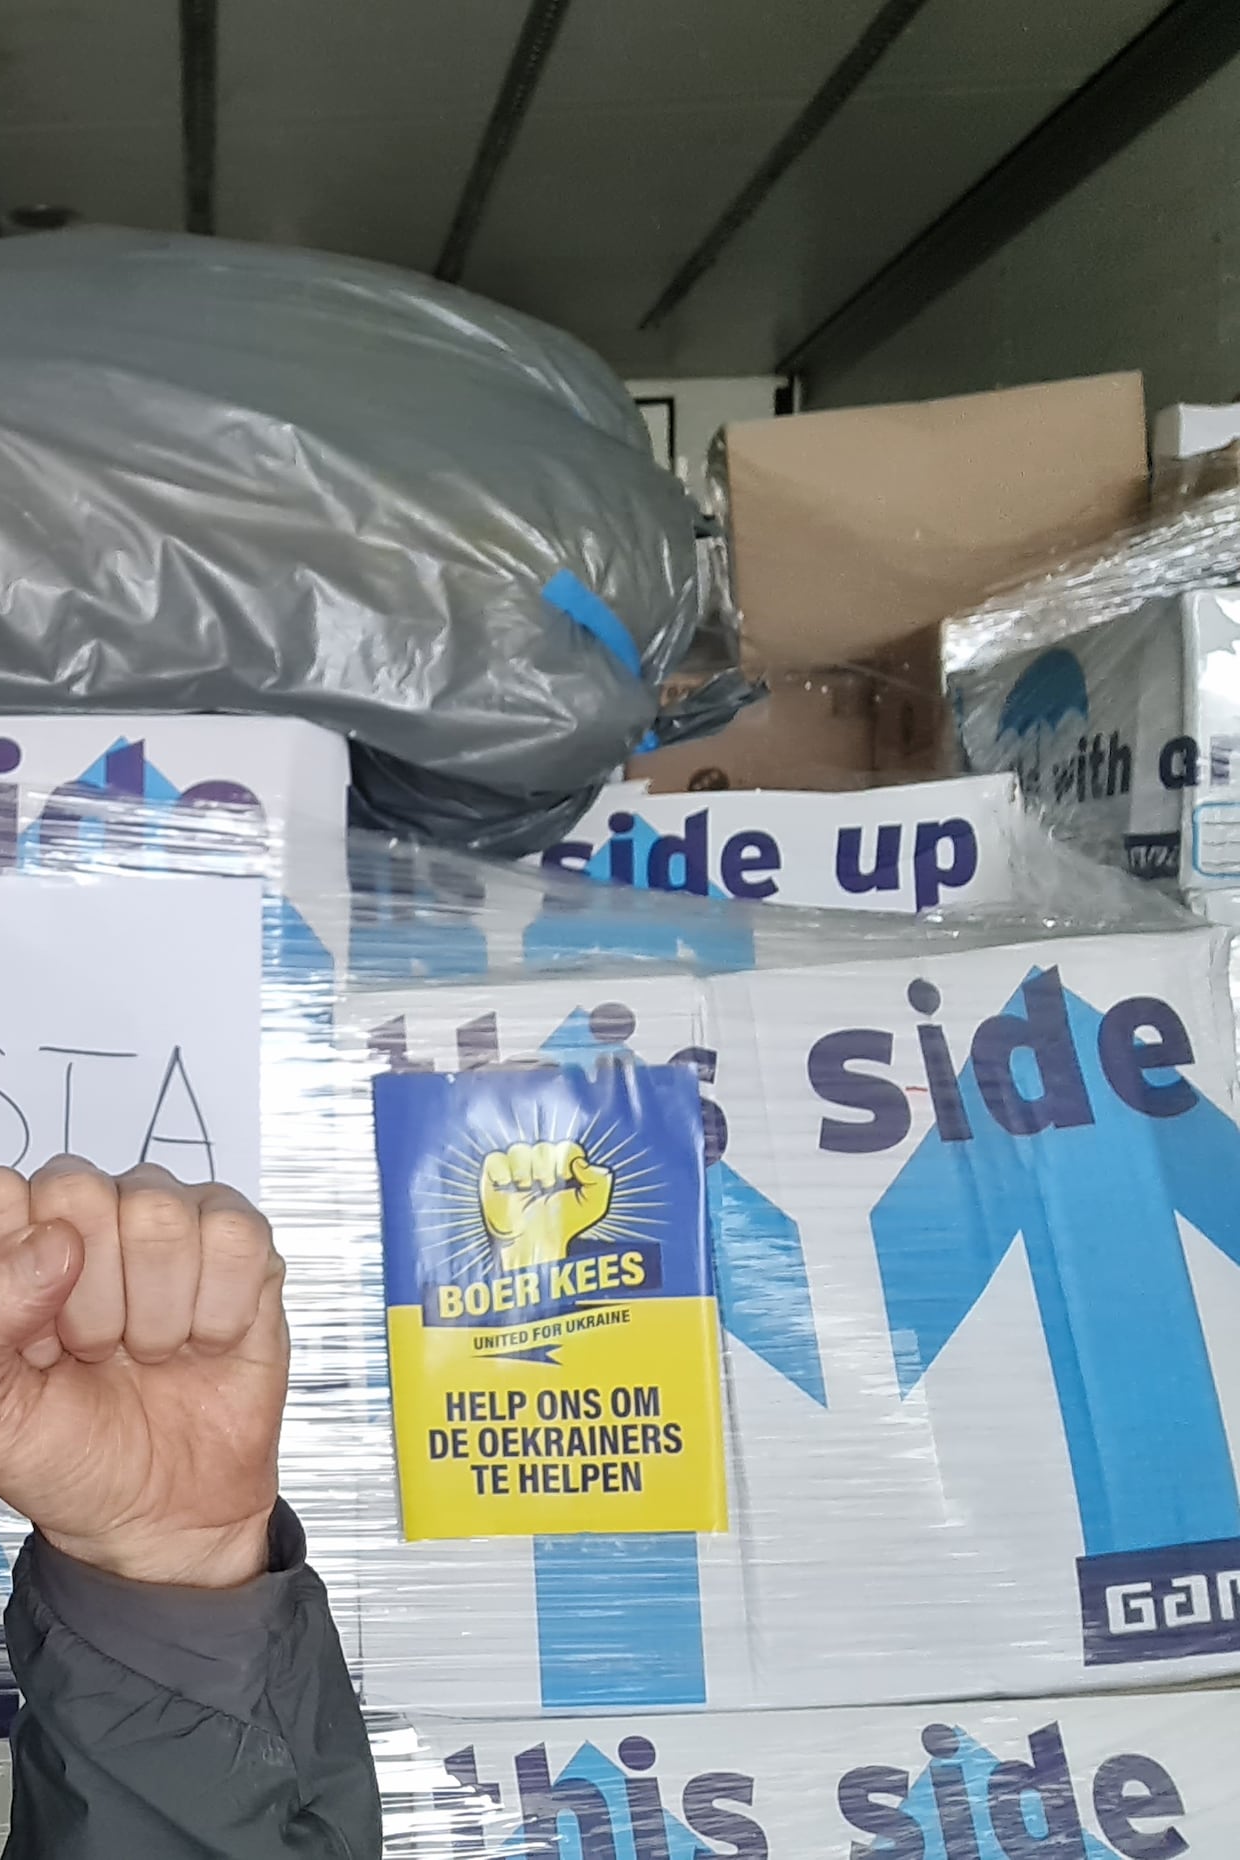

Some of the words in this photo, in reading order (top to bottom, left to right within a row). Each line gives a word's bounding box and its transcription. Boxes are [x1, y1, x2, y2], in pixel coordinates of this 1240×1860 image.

[835, 816, 979, 913] up
[807, 965, 1200, 1155] side
[438, 1271, 541, 1319] BOER
[549, 1250, 646, 1300] KEES
[473, 1330, 529, 1351] UNITED
[532, 1322, 562, 1342] FOR
[566, 1308, 632, 1334] UKRAINE
[446, 1390, 528, 1422] HELP
[537, 1387, 603, 1421] ONS
[610, 1386, 661, 1418] OM
[428, 1428, 470, 1460] DE
[478, 1422, 683, 1458] OEKRAINERS
[470, 1463, 510, 1495] TE
[518, 1461, 644, 1494] HELPEN
[434, 1736, 769, 1860] this
[838, 1721, 1190, 1860] side
